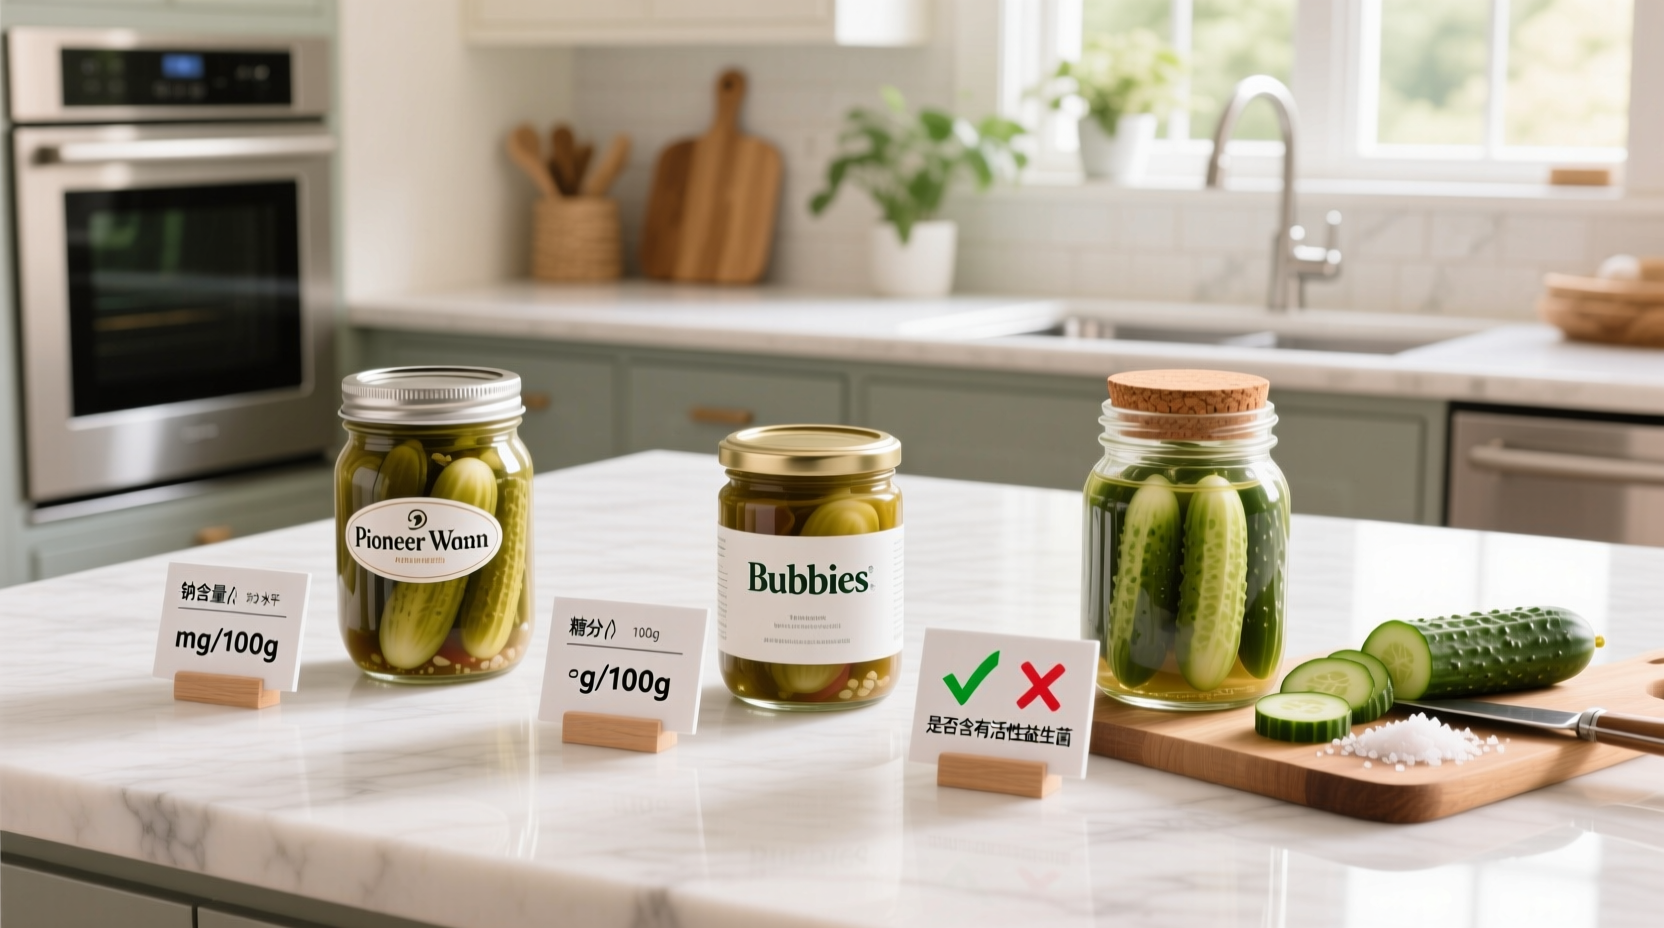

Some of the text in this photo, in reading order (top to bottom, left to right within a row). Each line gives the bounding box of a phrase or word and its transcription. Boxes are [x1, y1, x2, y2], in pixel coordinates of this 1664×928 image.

[355, 526, 425, 551] Pioneer
[747, 561, 869, 595] Bubbies
[175, 628, 279, 663] mg/100g
[633, 626, 660, 642] 100g
